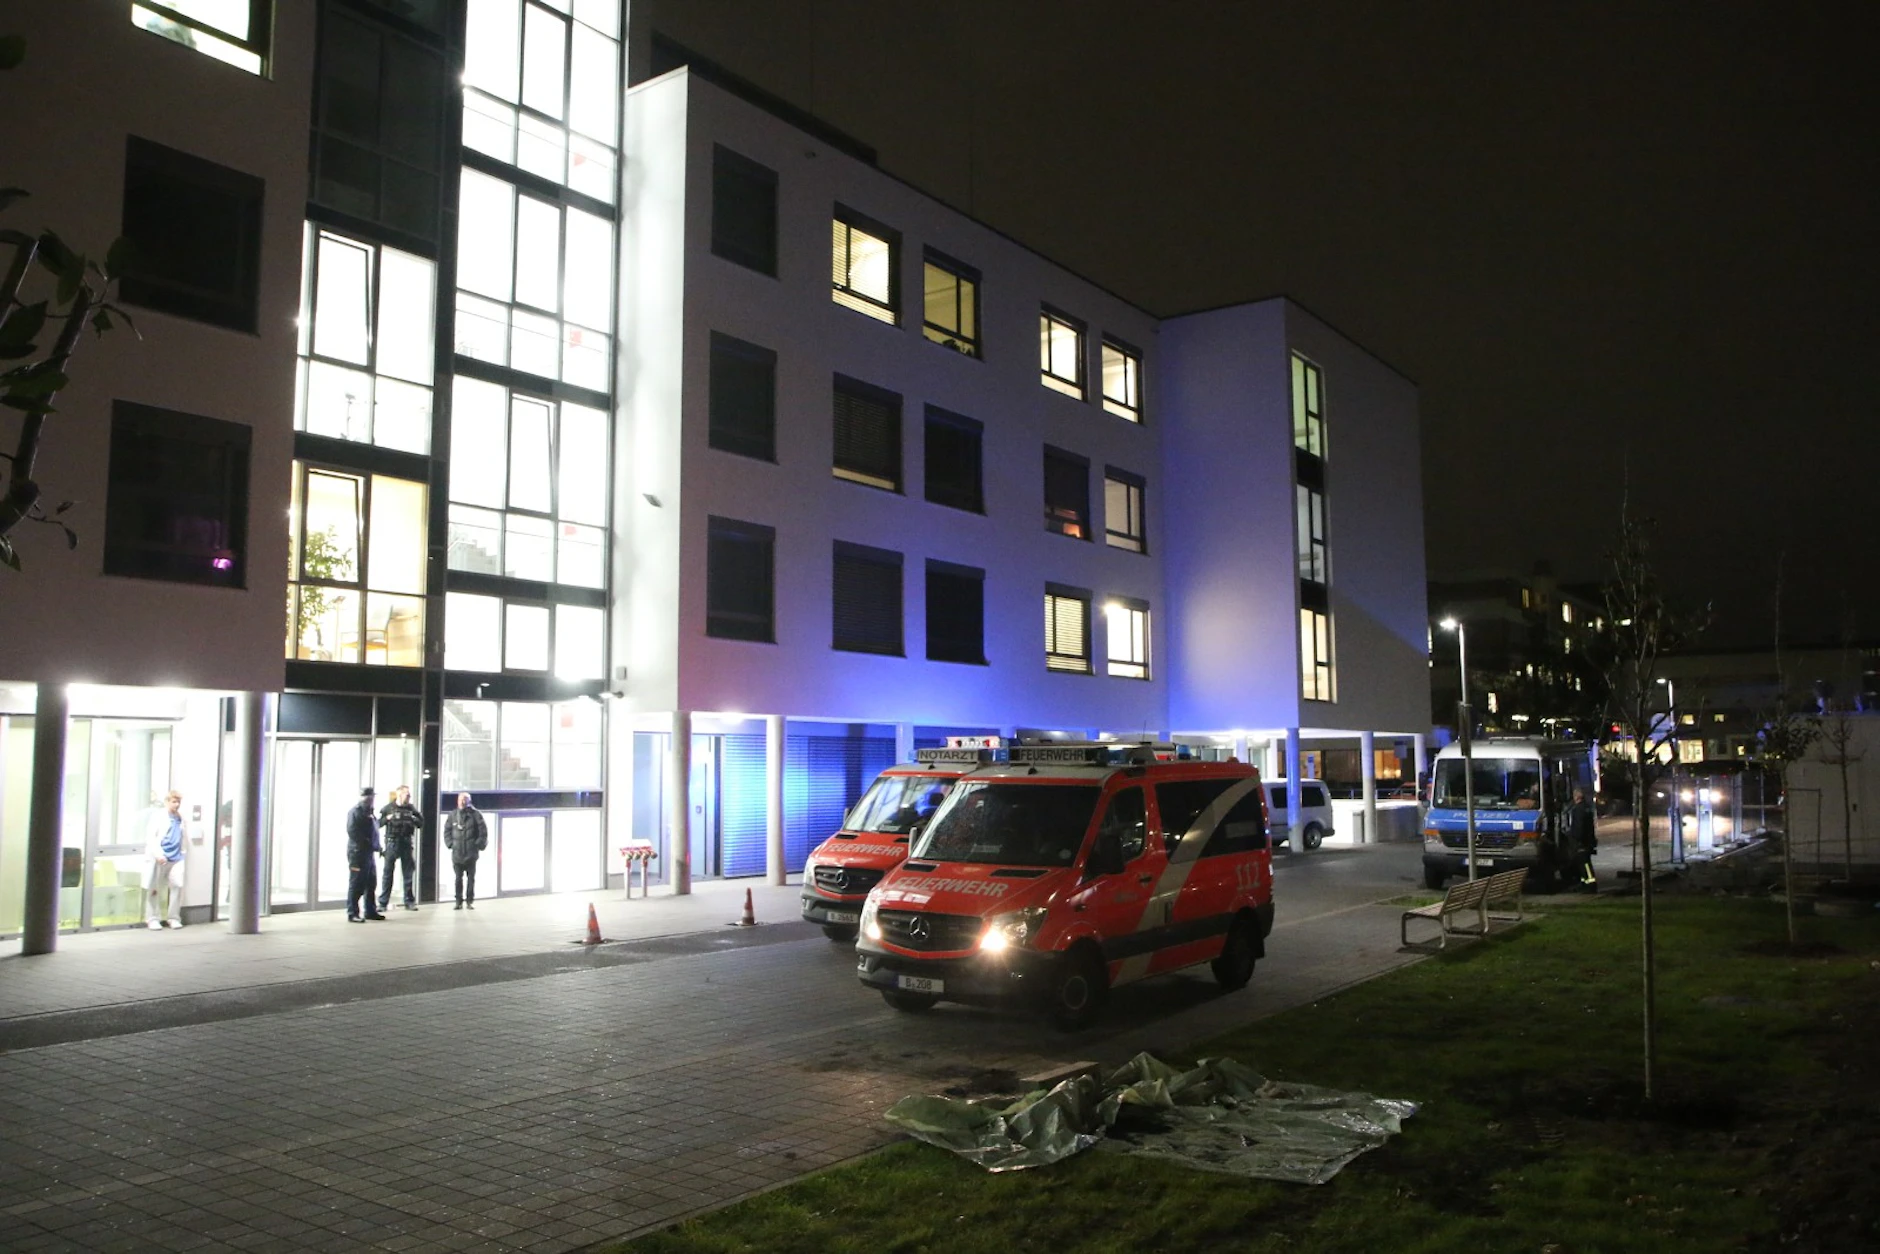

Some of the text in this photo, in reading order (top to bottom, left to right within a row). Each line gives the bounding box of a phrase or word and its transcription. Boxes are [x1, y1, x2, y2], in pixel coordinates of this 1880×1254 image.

[920, 750, 975, 760] NOTARZT
[1020, 749, 1083, 760] FEUERWEHR
[827, 843, 905, 858] FEUERWEHR
[1235, 861, 1261, 891] 112
[896, 875, 1009, 898] FEUERWEHR
